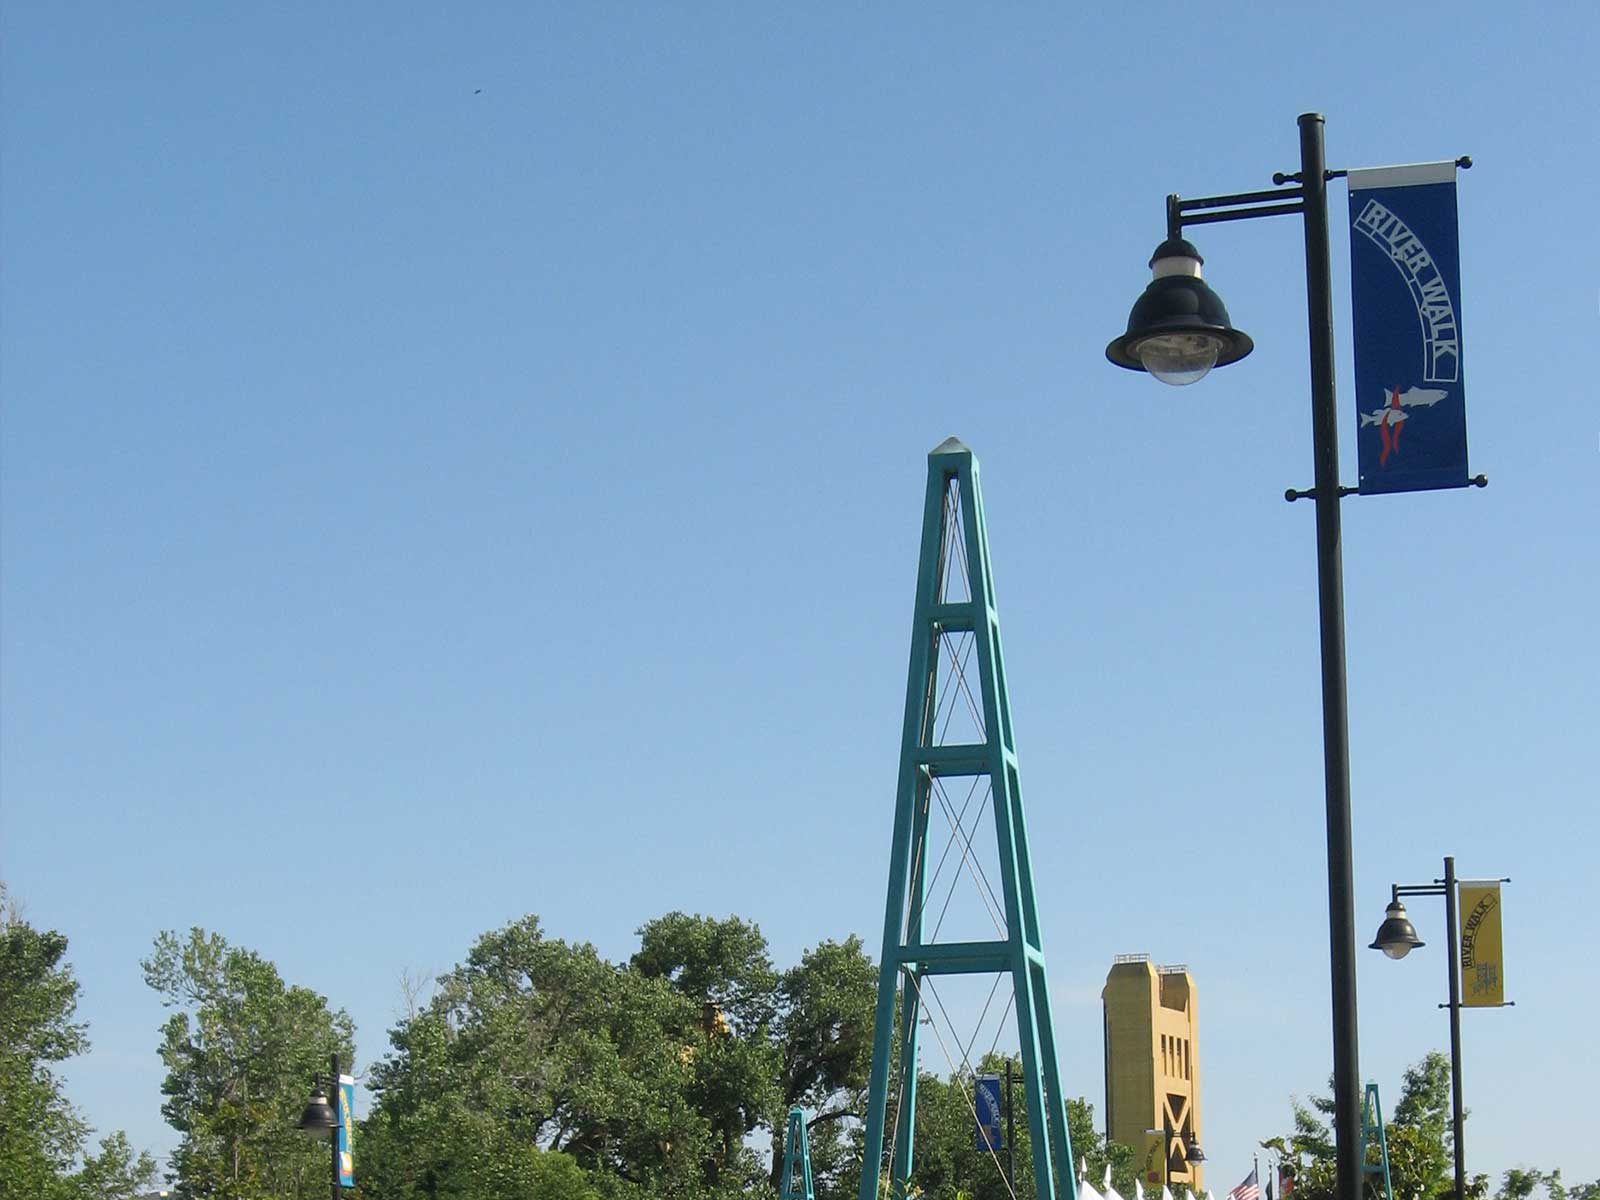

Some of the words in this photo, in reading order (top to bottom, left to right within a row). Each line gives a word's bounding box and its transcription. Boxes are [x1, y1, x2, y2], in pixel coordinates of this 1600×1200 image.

[1363, 202, 1430, 275] RIVER
[1422, 275, 1457, 359] WALK
[1466, 900, 1488, 931] WALK
[1461, 935, 1473, 968] RIVER
